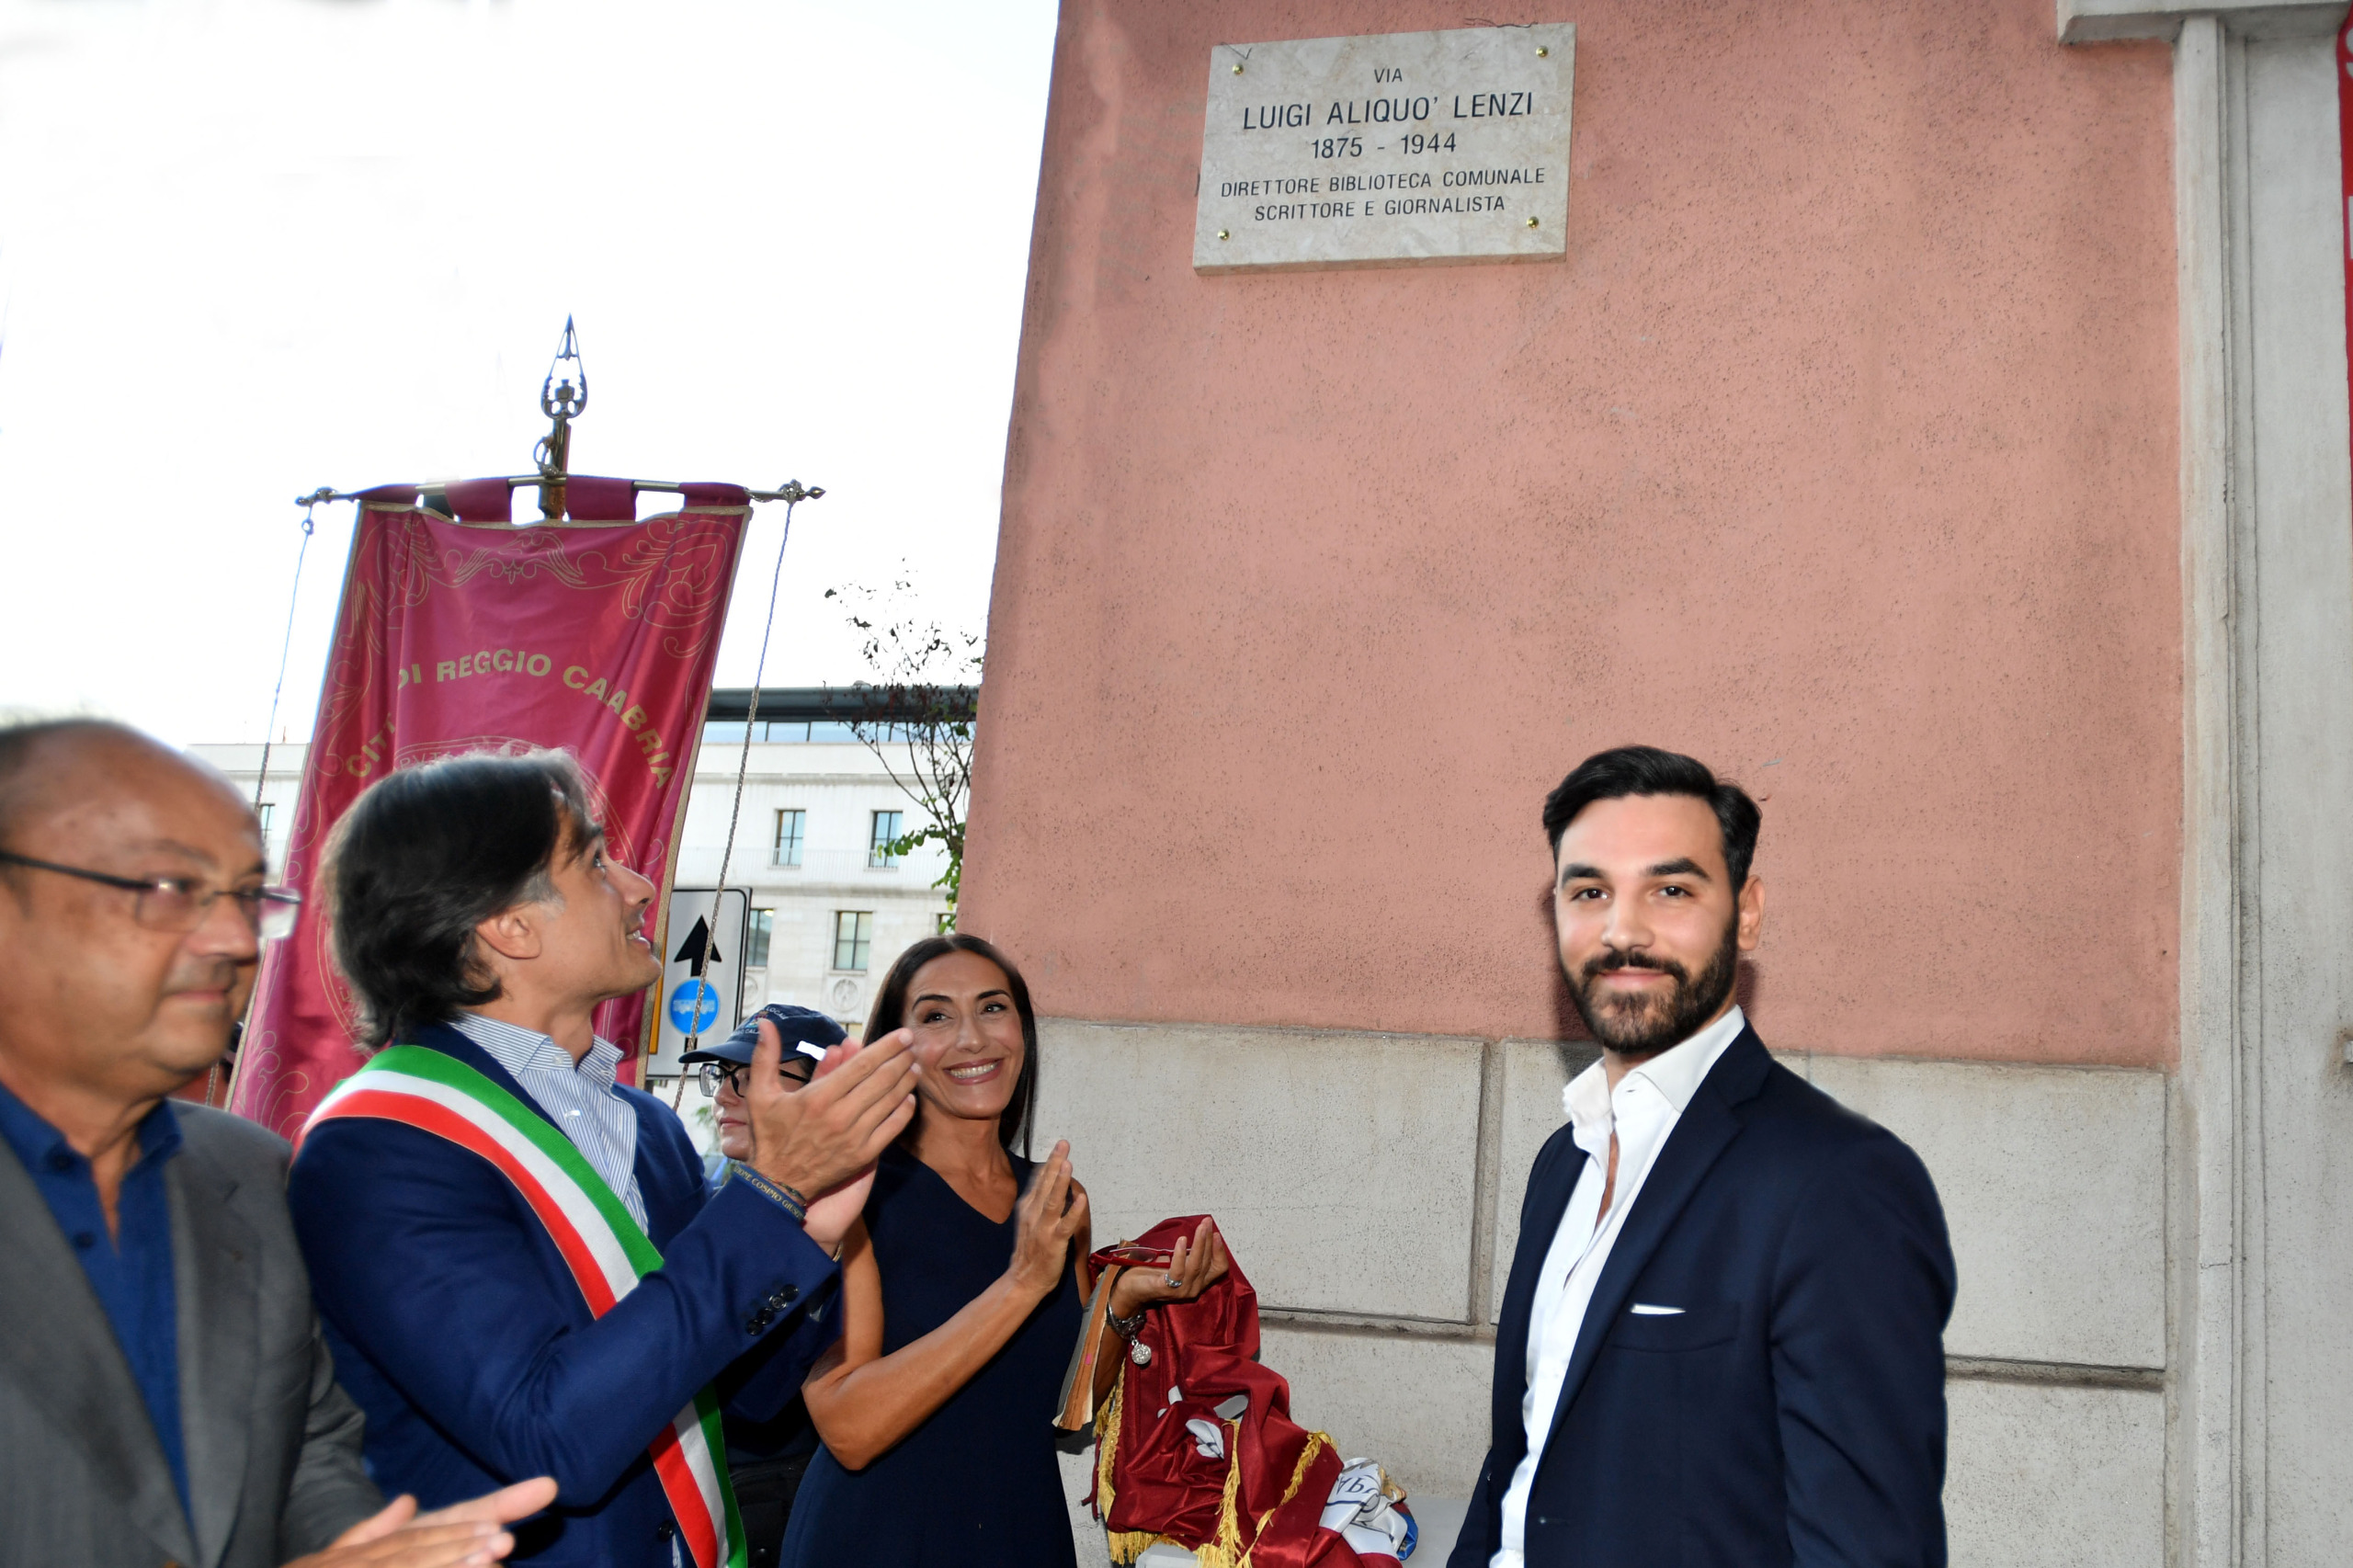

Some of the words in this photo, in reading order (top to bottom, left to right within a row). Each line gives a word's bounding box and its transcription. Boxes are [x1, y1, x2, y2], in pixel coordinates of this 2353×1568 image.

[1373, 67, 1403, 84] VIA
[1243, 103, 1312, 131] LUIGI
[1453, 92, 1532, 119] LENZI
[1312, 137, 1363, 159] 1875
[1401, 132, 1457, 155] 1944
[1221, 177, 1320, 198] DIRETTORE
[1329, 173, 1432, 192] BIBLIOTECA
[1442, 167, 1546, 187] COMUNALE
[1255, 201, 1356, 222] SCRITTORE
[1365, 200, 1375, 216] E
[1384, 196, 1506, 215] GIORNALISTA
[346, 711, 396, 778] CITT
[437, 648, 551, 683] REGGIO
[563, 665, 673, 790] CAABRIA
[751, 1176, 783, 1203] COSIMO
